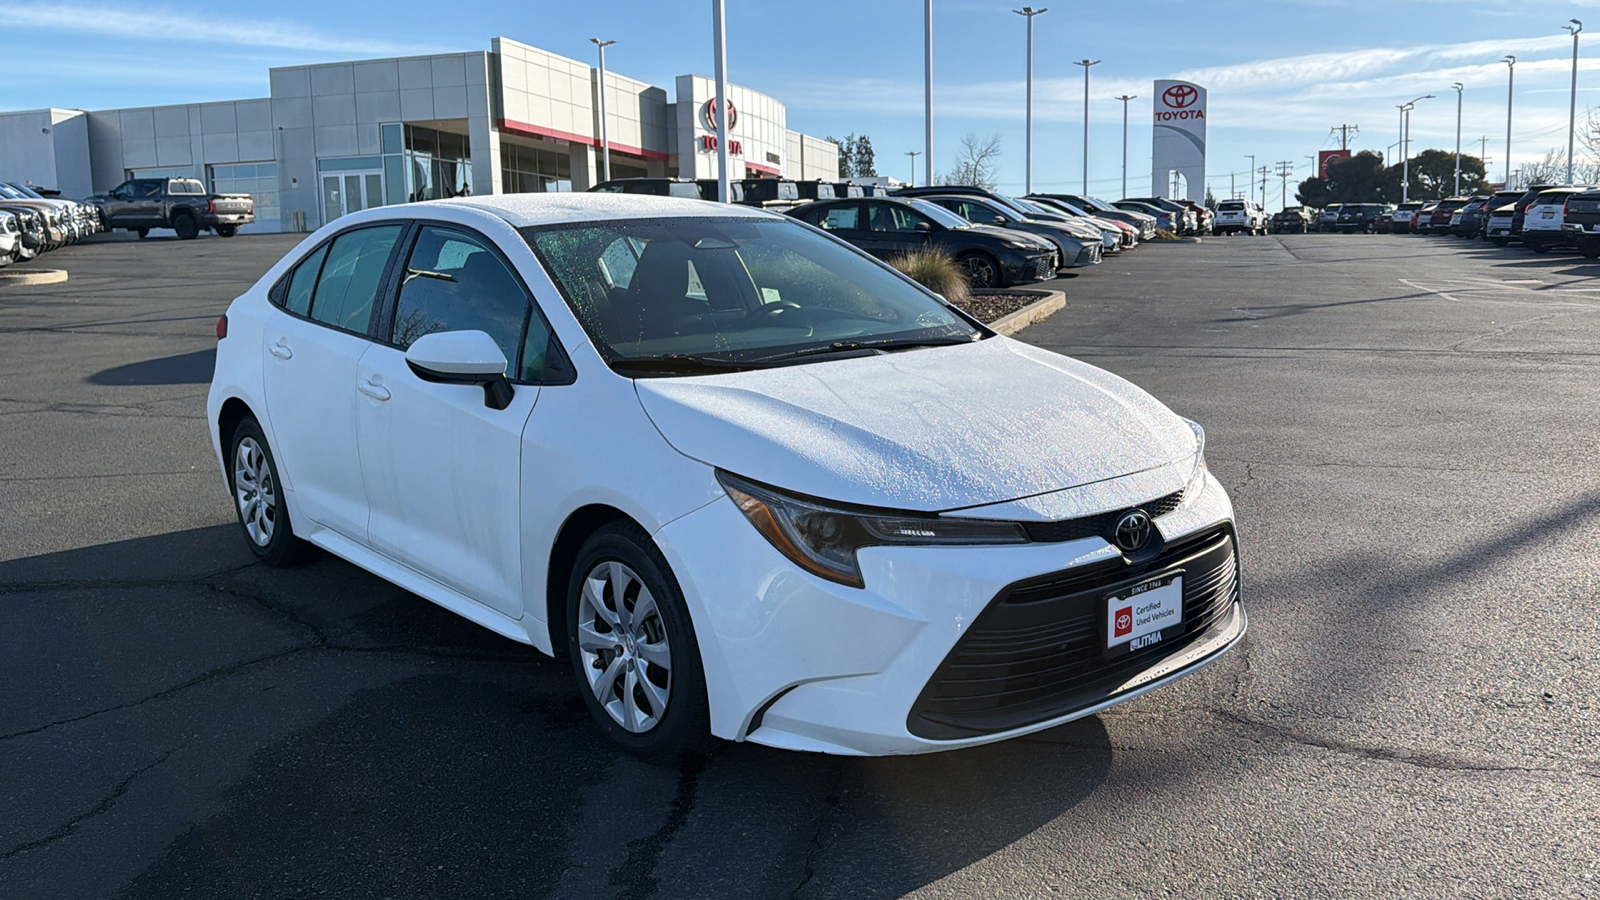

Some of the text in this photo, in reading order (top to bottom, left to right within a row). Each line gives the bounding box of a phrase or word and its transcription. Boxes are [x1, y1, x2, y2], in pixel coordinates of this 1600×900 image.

[1155, 109, 1204, 121] TOYOTA
[702, 135, 743, 154] TOTA
[1131, 580, 1161, 595] SINCE 1946
[1136, 600, 1161, 615] Certified
[1136, 608, 1175, 626] Used Vehicles
[1135, 630, 1162, 649] LITHIA
